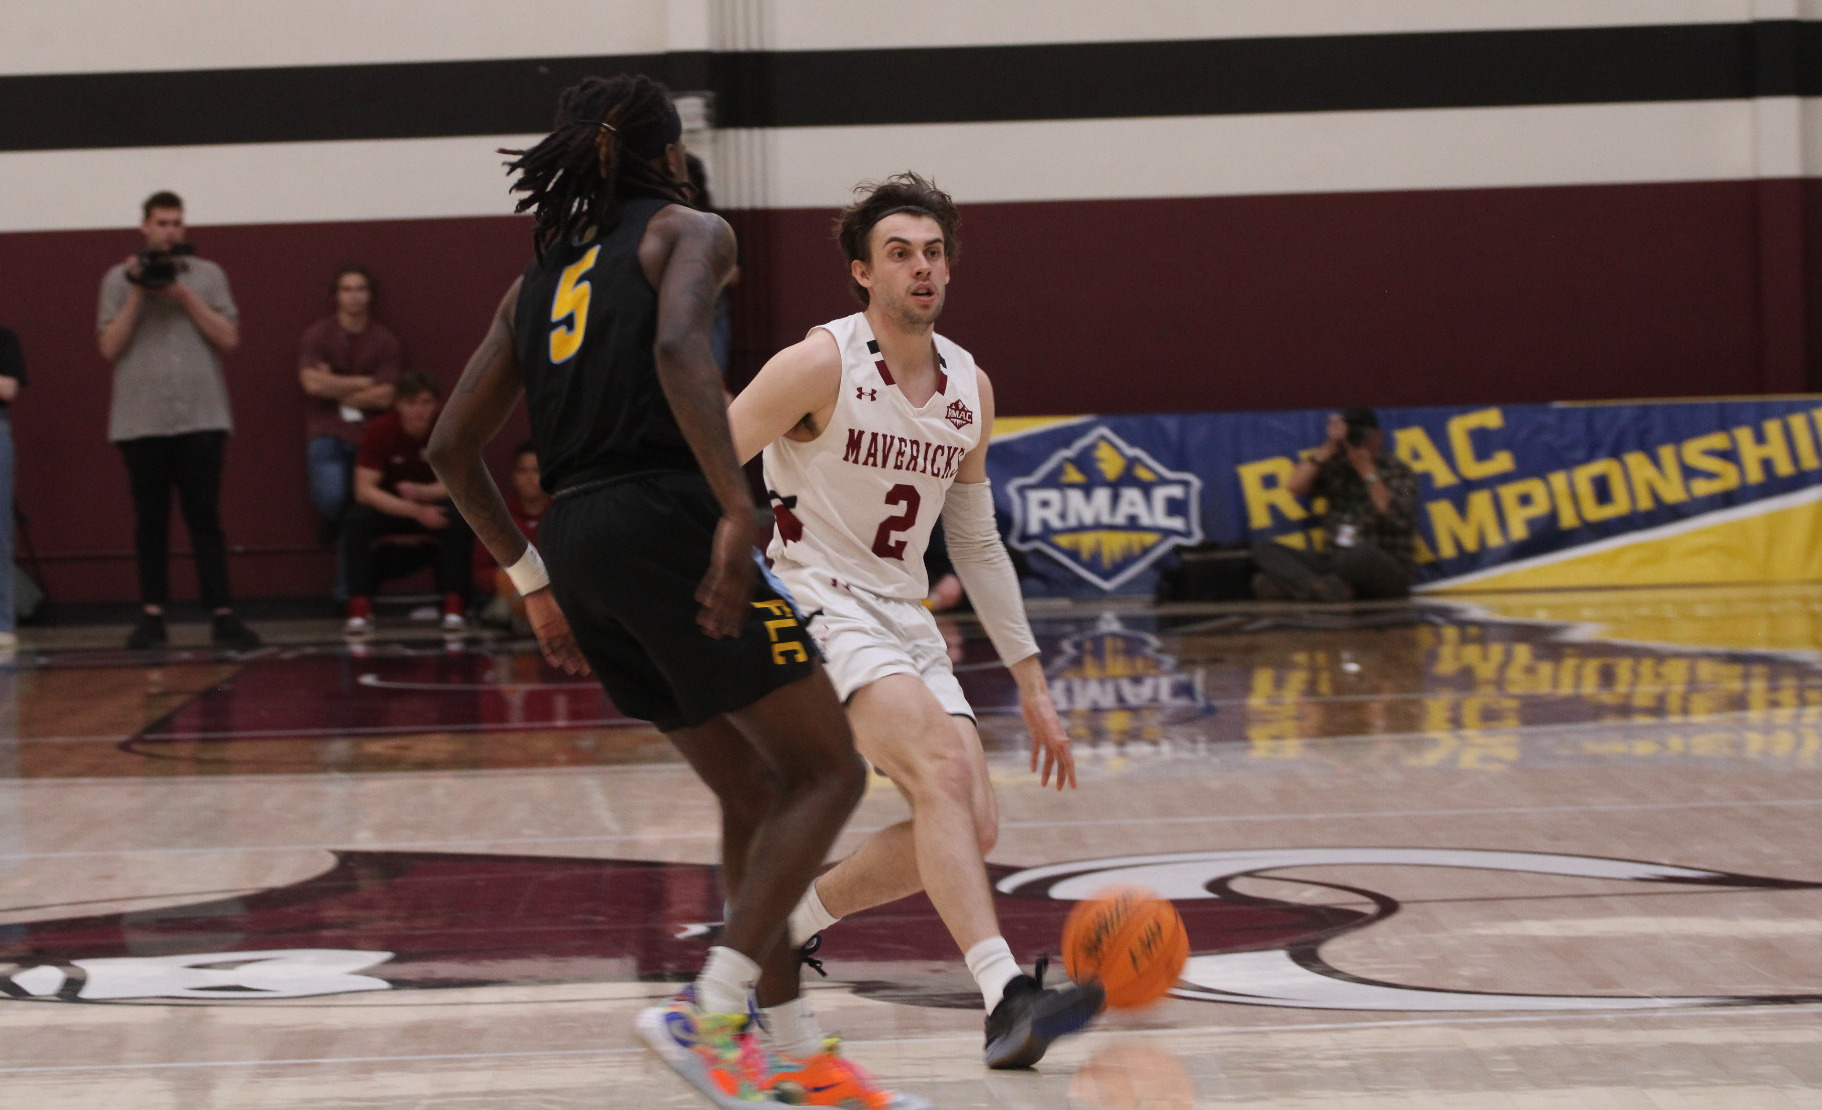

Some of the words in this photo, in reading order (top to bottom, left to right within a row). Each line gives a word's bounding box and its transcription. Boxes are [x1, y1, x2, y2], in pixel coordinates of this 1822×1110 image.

[549, 244, 602, 365] 5
[1236, 408, 1516, 531] RAC
[871, 483, 922, 561] 2
[1024, 484, 1189, 535] RMAC
[751, 599, 809, 665] FLC
